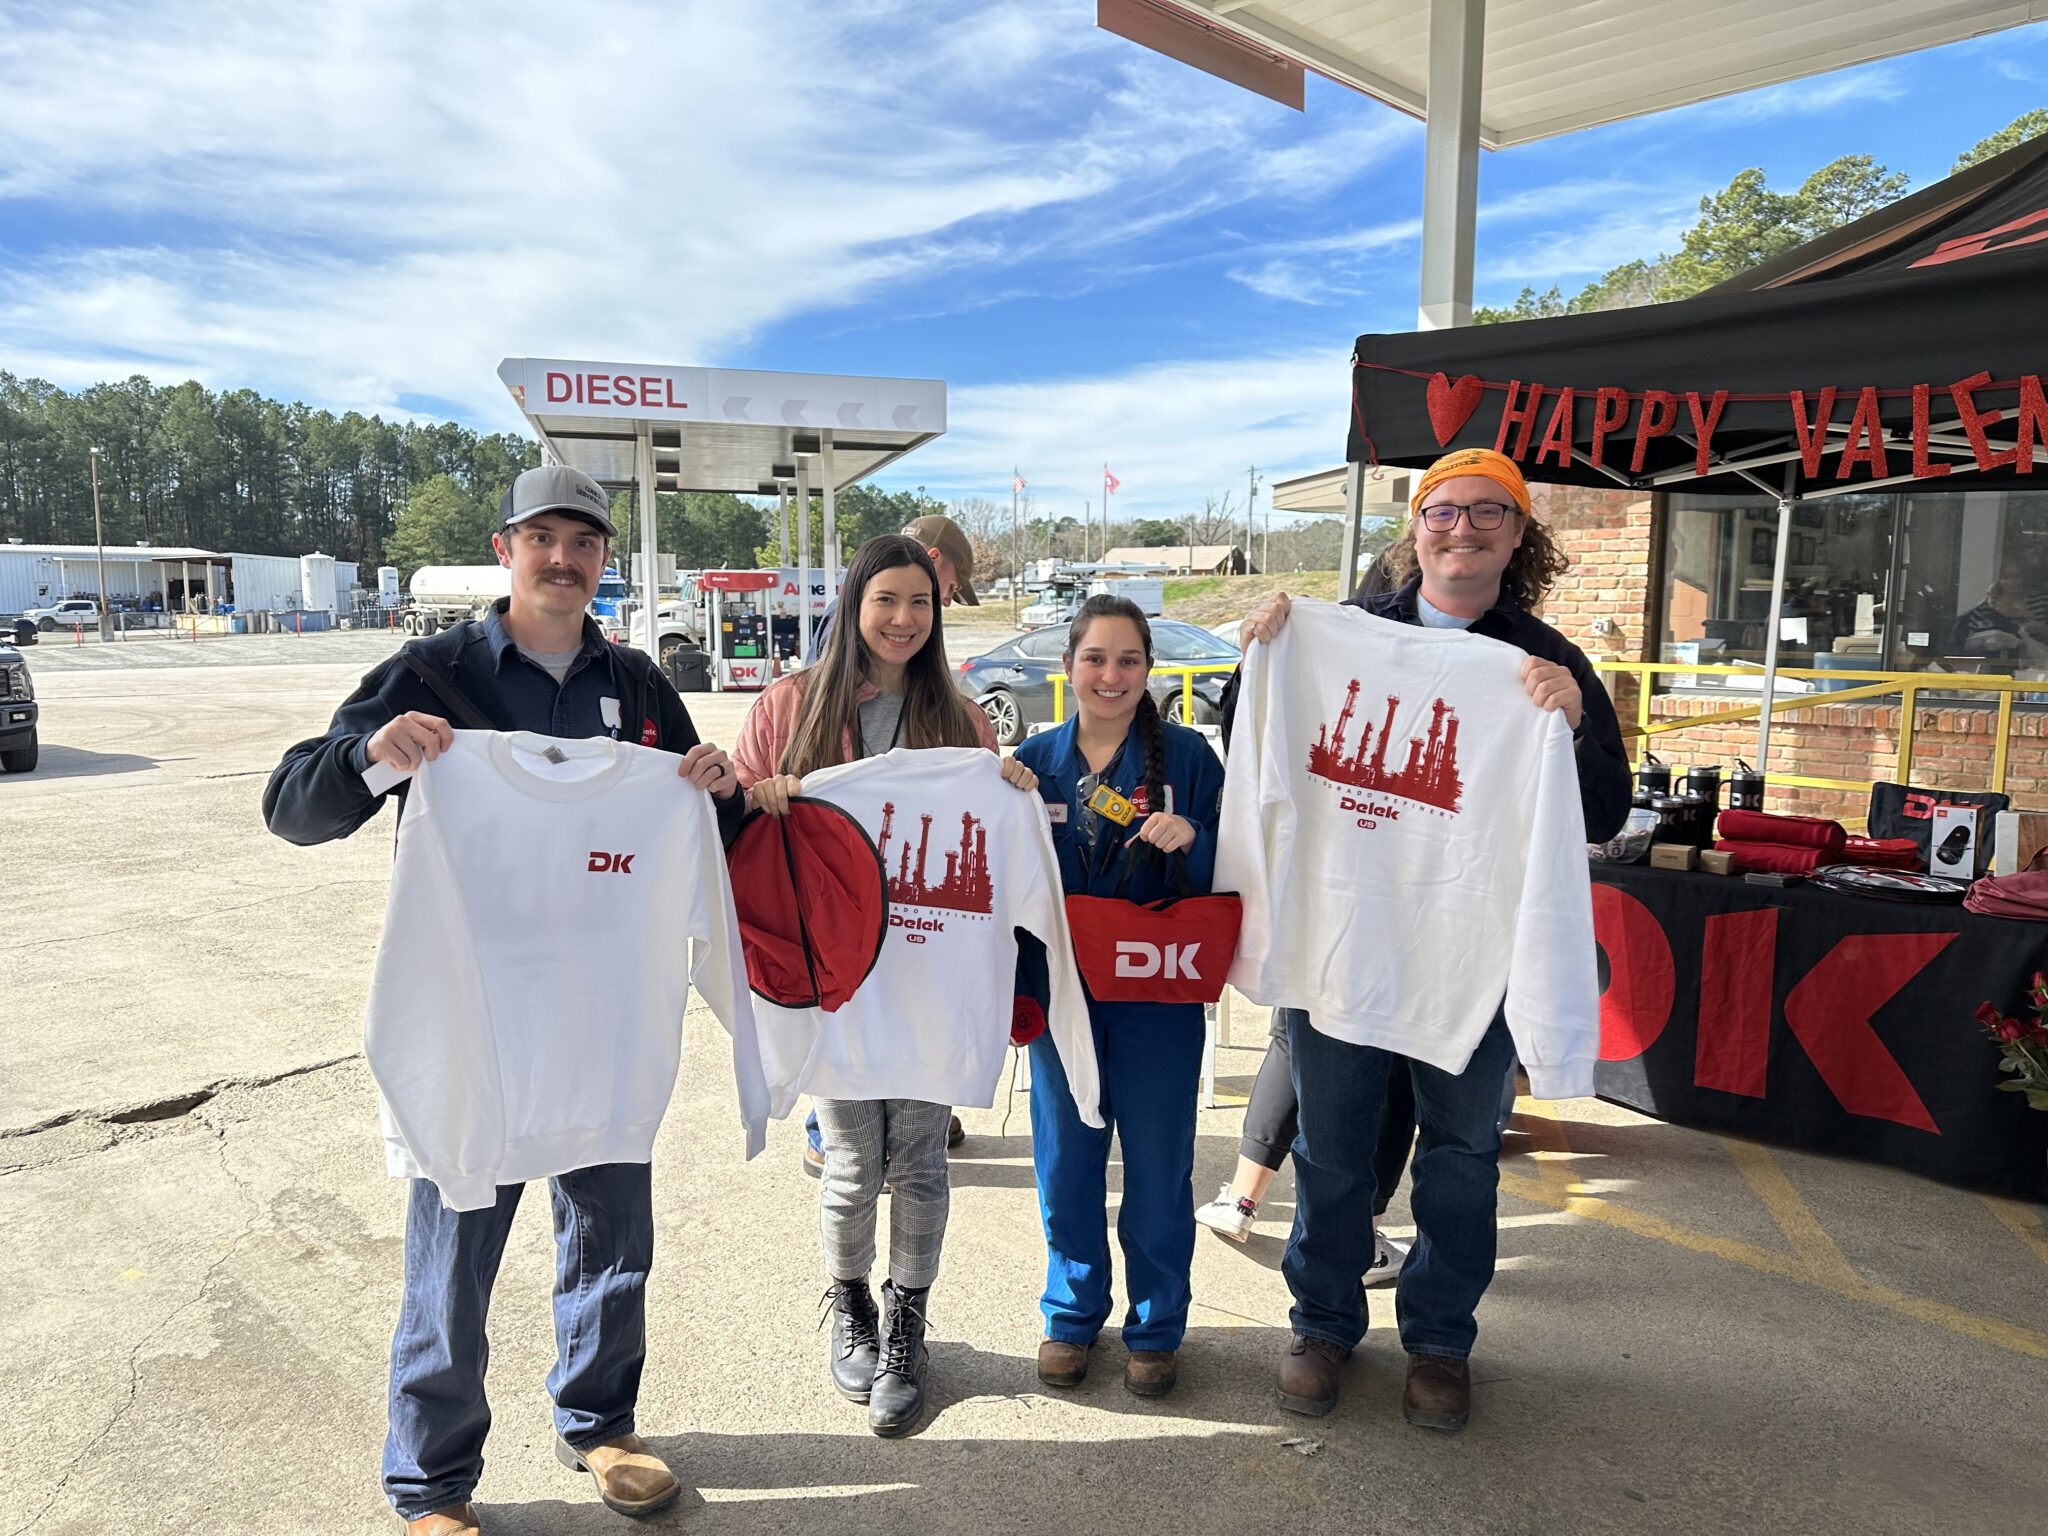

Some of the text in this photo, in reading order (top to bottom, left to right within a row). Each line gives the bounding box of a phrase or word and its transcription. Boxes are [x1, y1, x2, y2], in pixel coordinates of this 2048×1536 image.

[547, 372, 688, 409] DIESEL
[1494, 380, 1729, 476] HAPPY
[732, 667, 758, 678] DK
[1340, 796, 1400, 821] Delek
[1384, 796, 1455, 820] REFINERY
[1731, 792, 1760, 807] DK
[1359, 819, 1375, 829] US
[588, 852, 635, 873] DK
[889, 914, 945, 933] Delek
[893, 906, 993, 921] ADO REFINERY
[908, 935, 925, 943] US
[1115, 941, 1203, 980] DK
